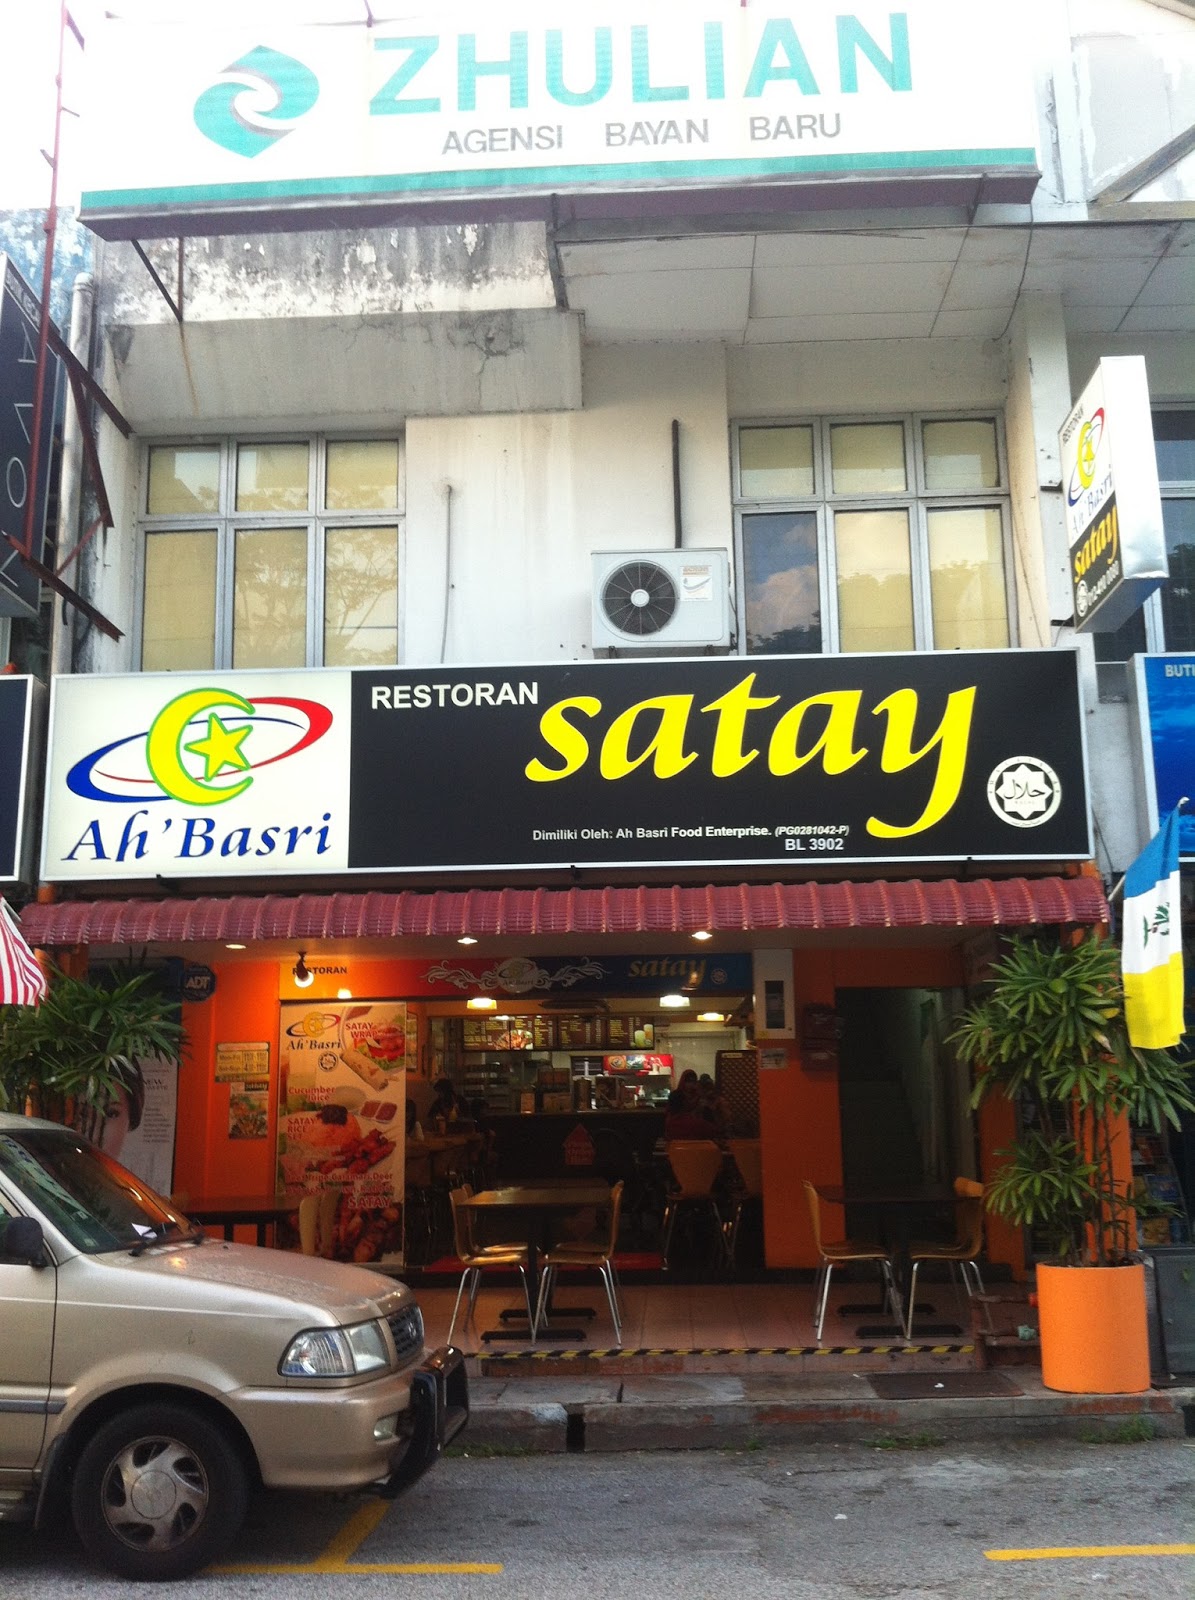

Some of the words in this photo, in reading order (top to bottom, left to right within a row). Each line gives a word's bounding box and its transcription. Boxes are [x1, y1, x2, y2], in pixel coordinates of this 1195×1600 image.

[369, 12, 913, 115] ZHULIAN
[442, 124, 563, 155] AGENSI
[605, 118, 710, 148] BAYAN
[749, 112, 842, 142] BARU
[1074, 504, 1119, 584] satay
[371, 682, 539, 710] RESTORAN
[525, 672, 977, 839] satay
[533, 828, 578, 841] Dimiliki
[580, 828, 613, 840] Oleh:
[616, 828, 634, 839] Ah
[636, 827, 668, 839] Basri
[671, 826, 703, 838] Food
[705, 825, 771, 838] Enterprise.
[785, 838, 806, 851] BL
[809, 838, 844, 851] 3902
[292, 966, 347, 975] RSTORAN
[185, 976, 210, 989] ADT
[345, 1022, 374, 1030] SATAY
[287, 1117, 316, 1125] SATAY
[347, 1195, 391, 1209] SATAY
